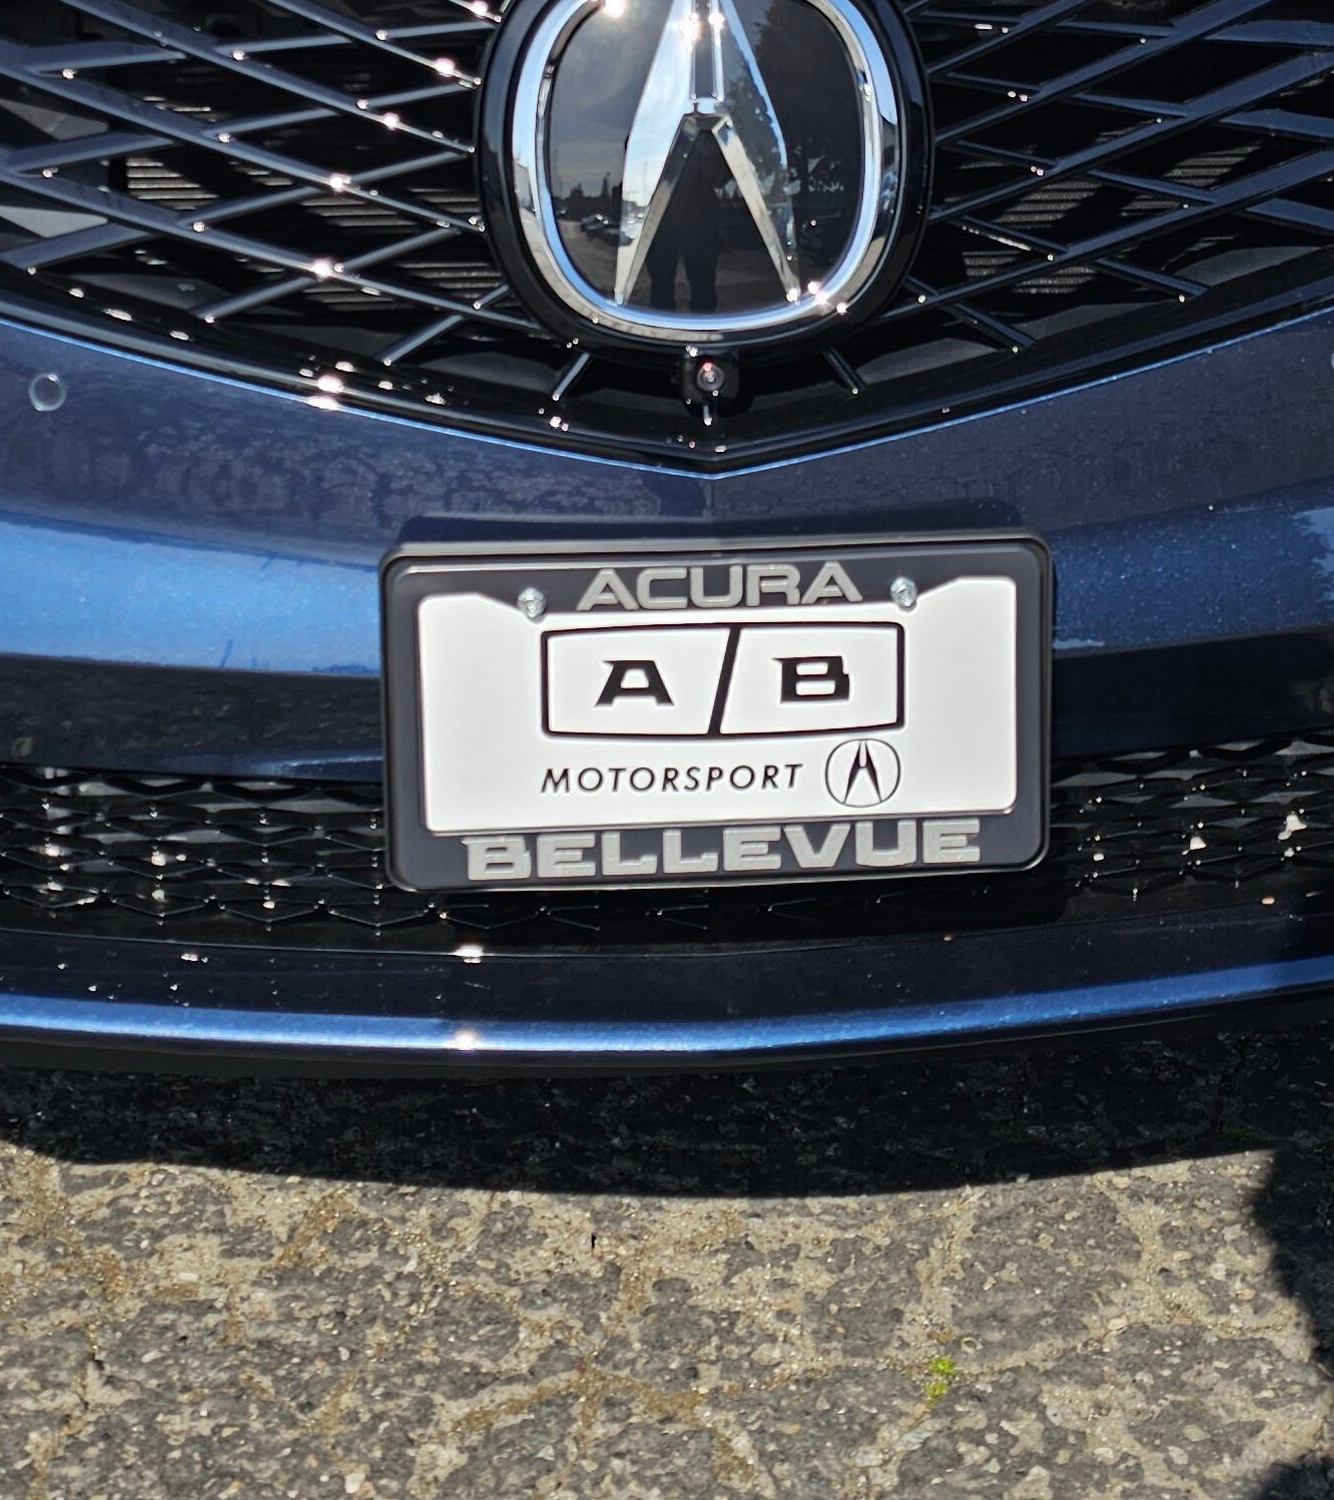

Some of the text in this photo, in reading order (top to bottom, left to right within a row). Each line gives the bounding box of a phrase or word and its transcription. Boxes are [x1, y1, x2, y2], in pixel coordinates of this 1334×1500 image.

[576, 562, 863, 612] ACURA
[541, 762, 804, 795] MOTORSPORT
[462, 818, 982, 881] BELLEVUE
